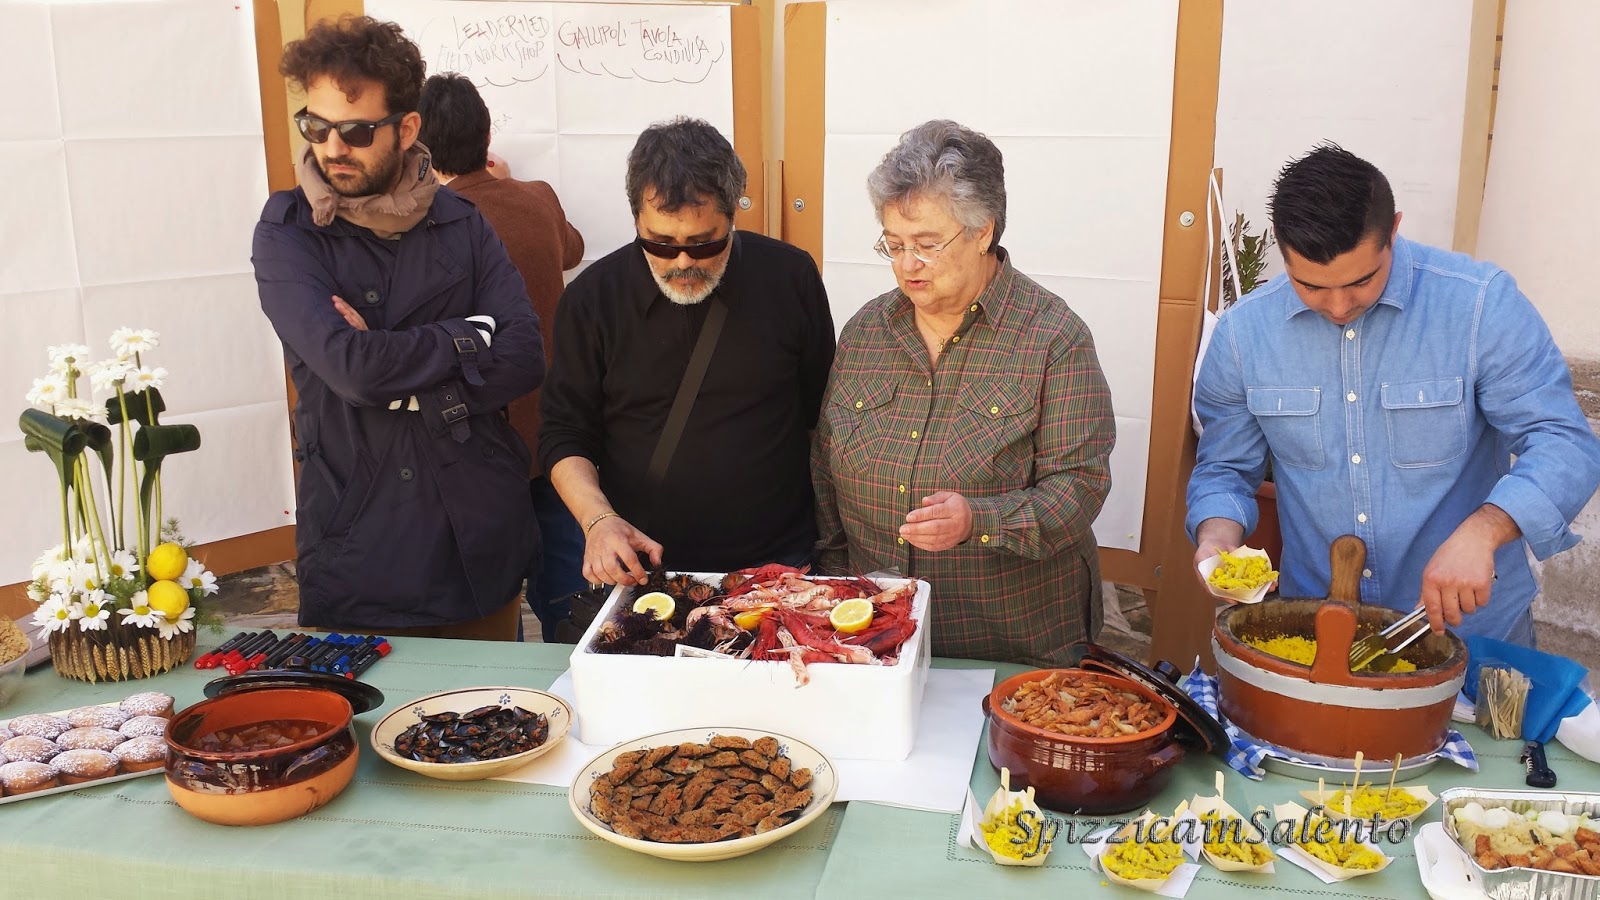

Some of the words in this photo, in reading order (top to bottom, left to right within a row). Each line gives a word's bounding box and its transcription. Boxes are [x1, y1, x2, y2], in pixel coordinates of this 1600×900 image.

[557, 20, 628, 50] GALLIPOLI
[631, 18, 683, 50] TAVOLA
[643, 35, 710, 65] CONDIVISA
